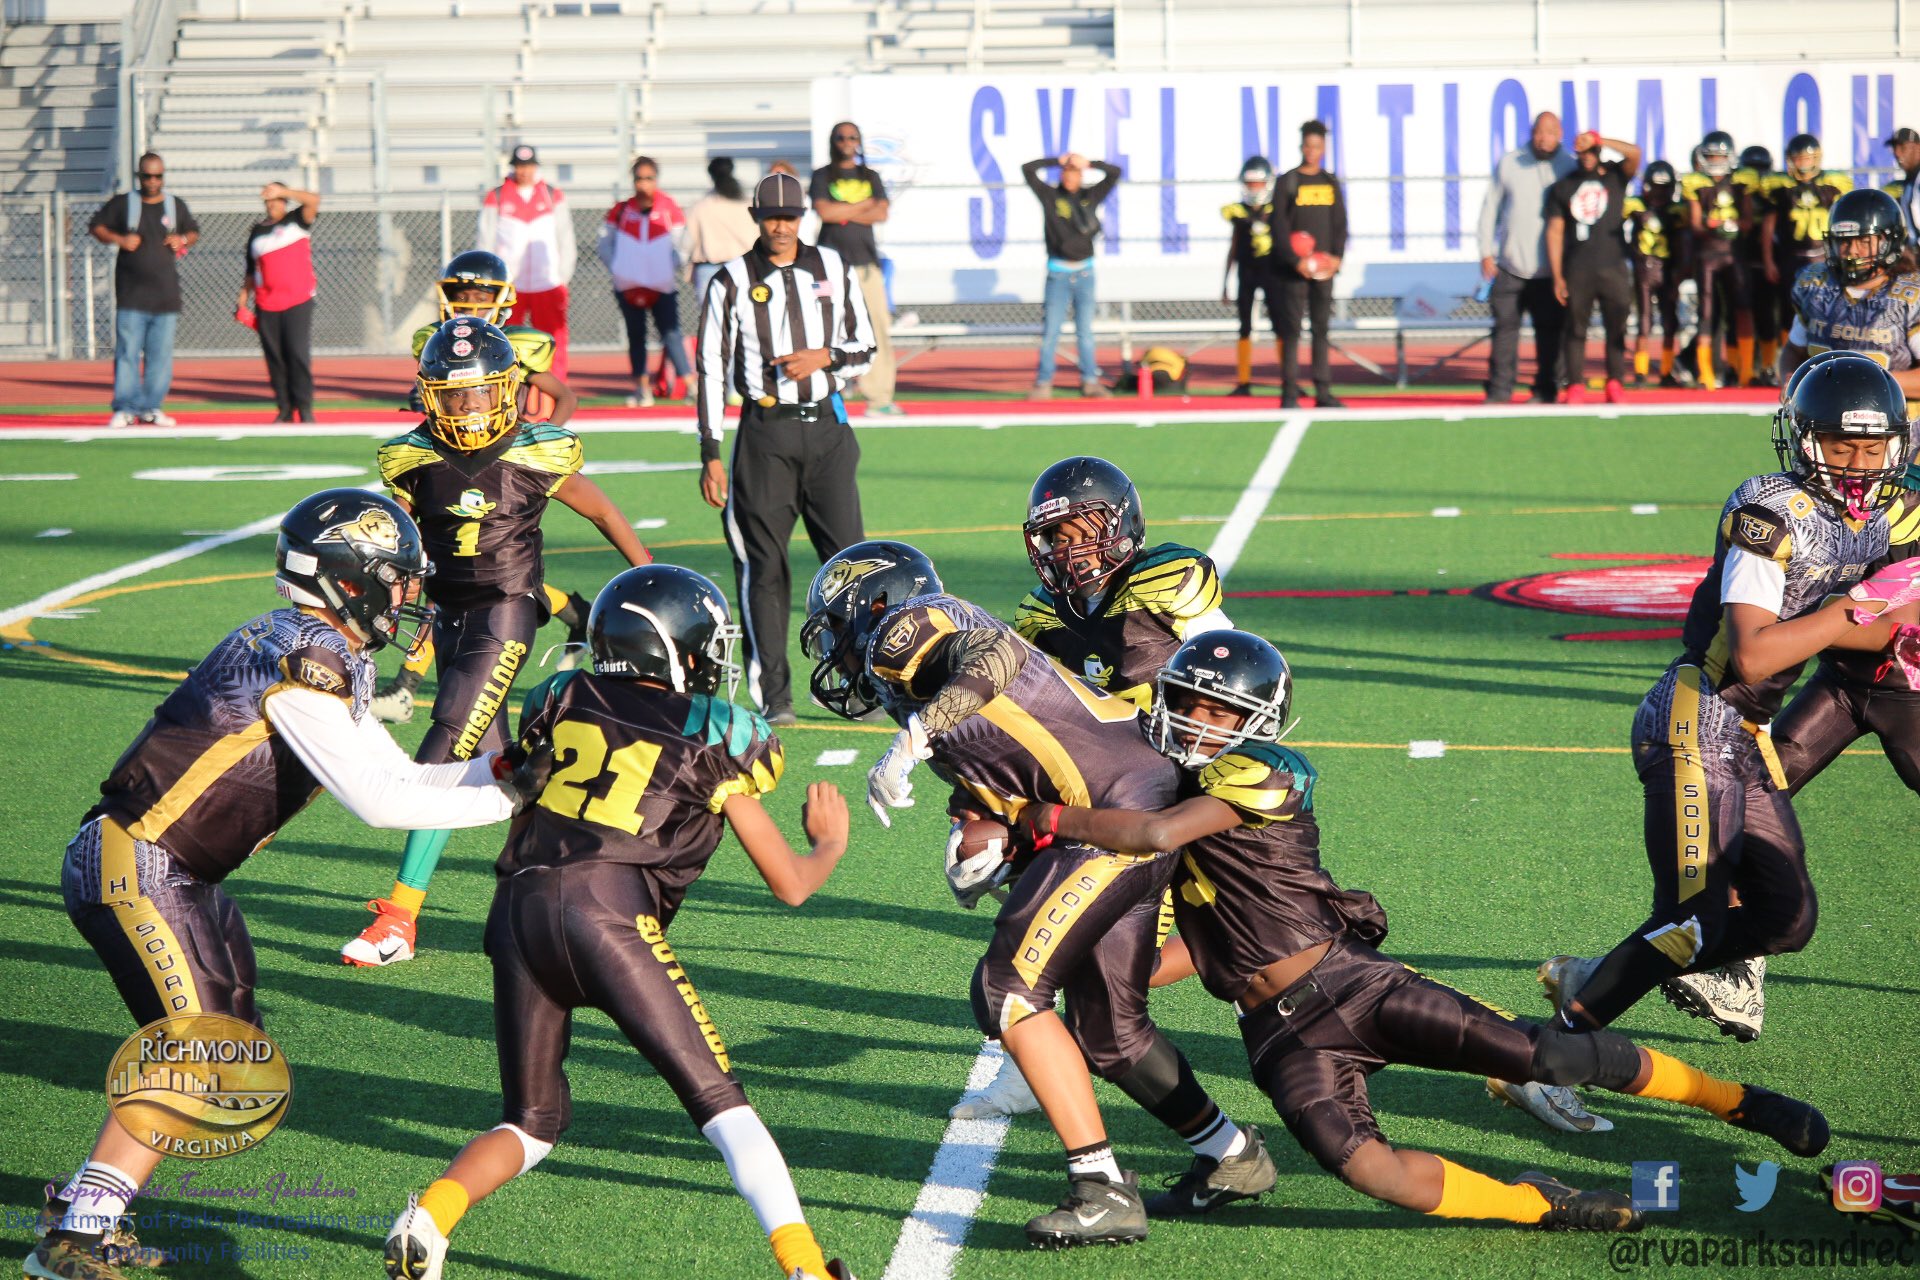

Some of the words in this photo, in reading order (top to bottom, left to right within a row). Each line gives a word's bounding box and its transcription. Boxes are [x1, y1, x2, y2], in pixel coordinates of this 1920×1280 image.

[1830, 322, 1893, 345] SQUAD
[453, 521, 482, 557] 1
[453, 639, 528, 761] SOUTHSIDE
[536, 719, 664, 837] 21
[1682, 783, 1701, 880] SQUAD
[1023, 875, 1098, 964] SQUAD
[135, 920, 188, 1012] SQUAD
